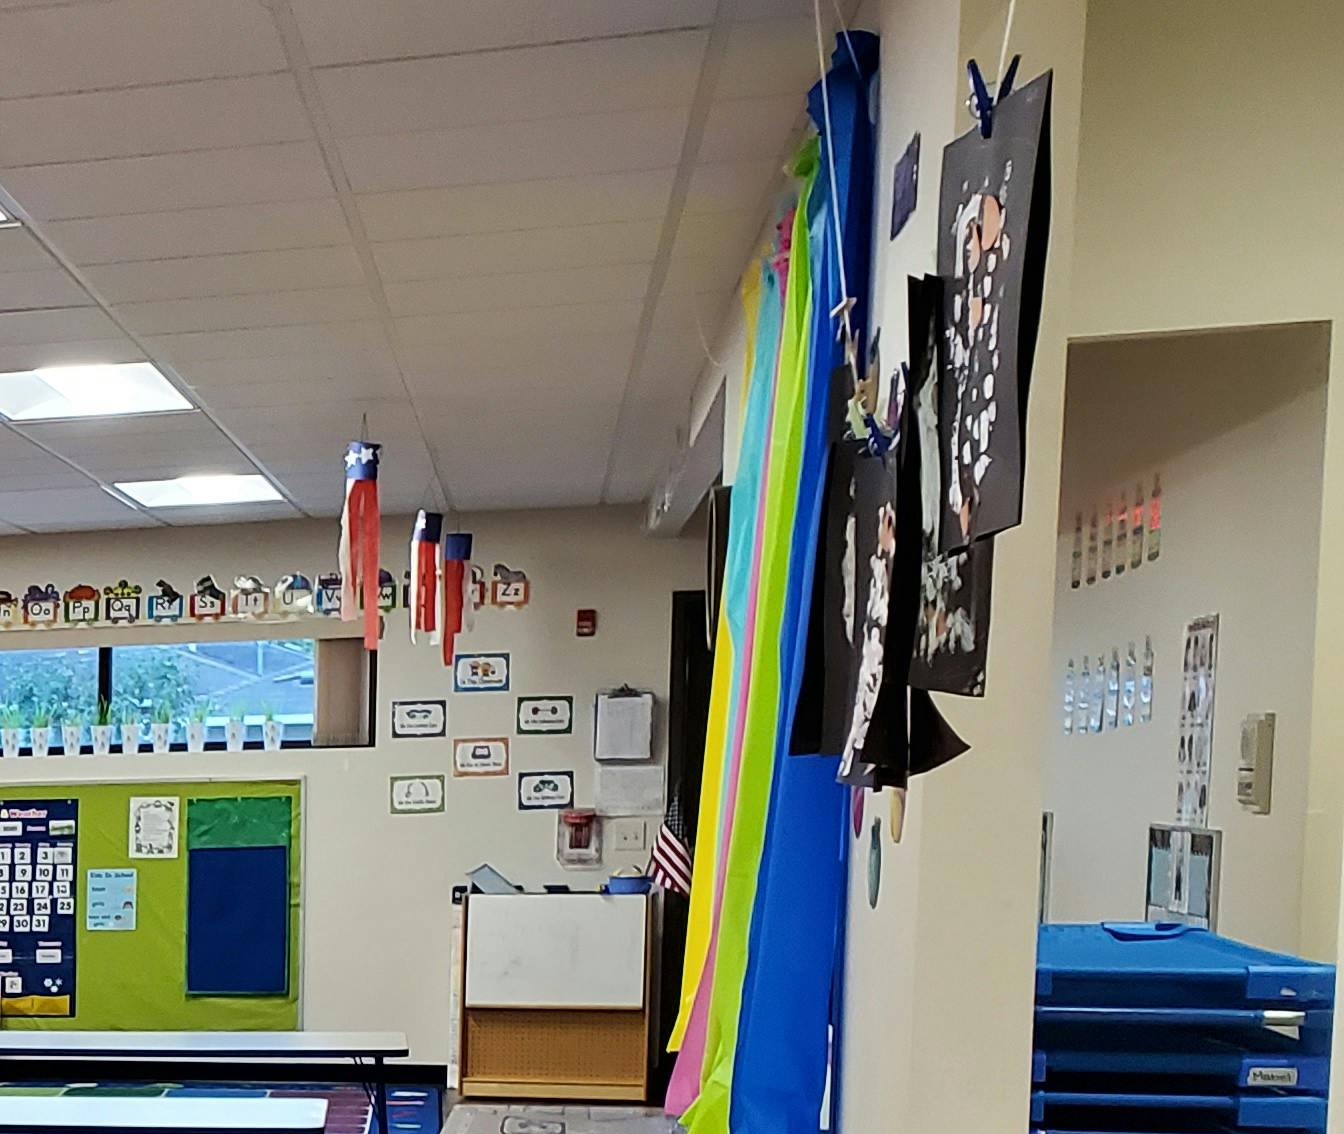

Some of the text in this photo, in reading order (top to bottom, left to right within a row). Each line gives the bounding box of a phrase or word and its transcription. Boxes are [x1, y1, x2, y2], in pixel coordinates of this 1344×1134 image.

[30, 602, 51, 616] Oo
[72, 602, 90, 619] Pp
[111, 600, 131, 616] Qq
[501, 583, 519, 596] Zz
[20, 852, 25, 860] 2
[42, 852, 48, 860] 3
[21, 869, 27, 877] 9
[39, 868, 49, 877] 10
[61, 869, 68, 877] 11
[16, 886, 25, 894] 16
[36, 885, 45, 894] 17
[13, 903, 24, 911] 23
[37, 903, 48, 911] 24
[60, 902, 71, 910] 25
[16, 920, 28, 928] 30
[35, 919, 45, 927] 31
